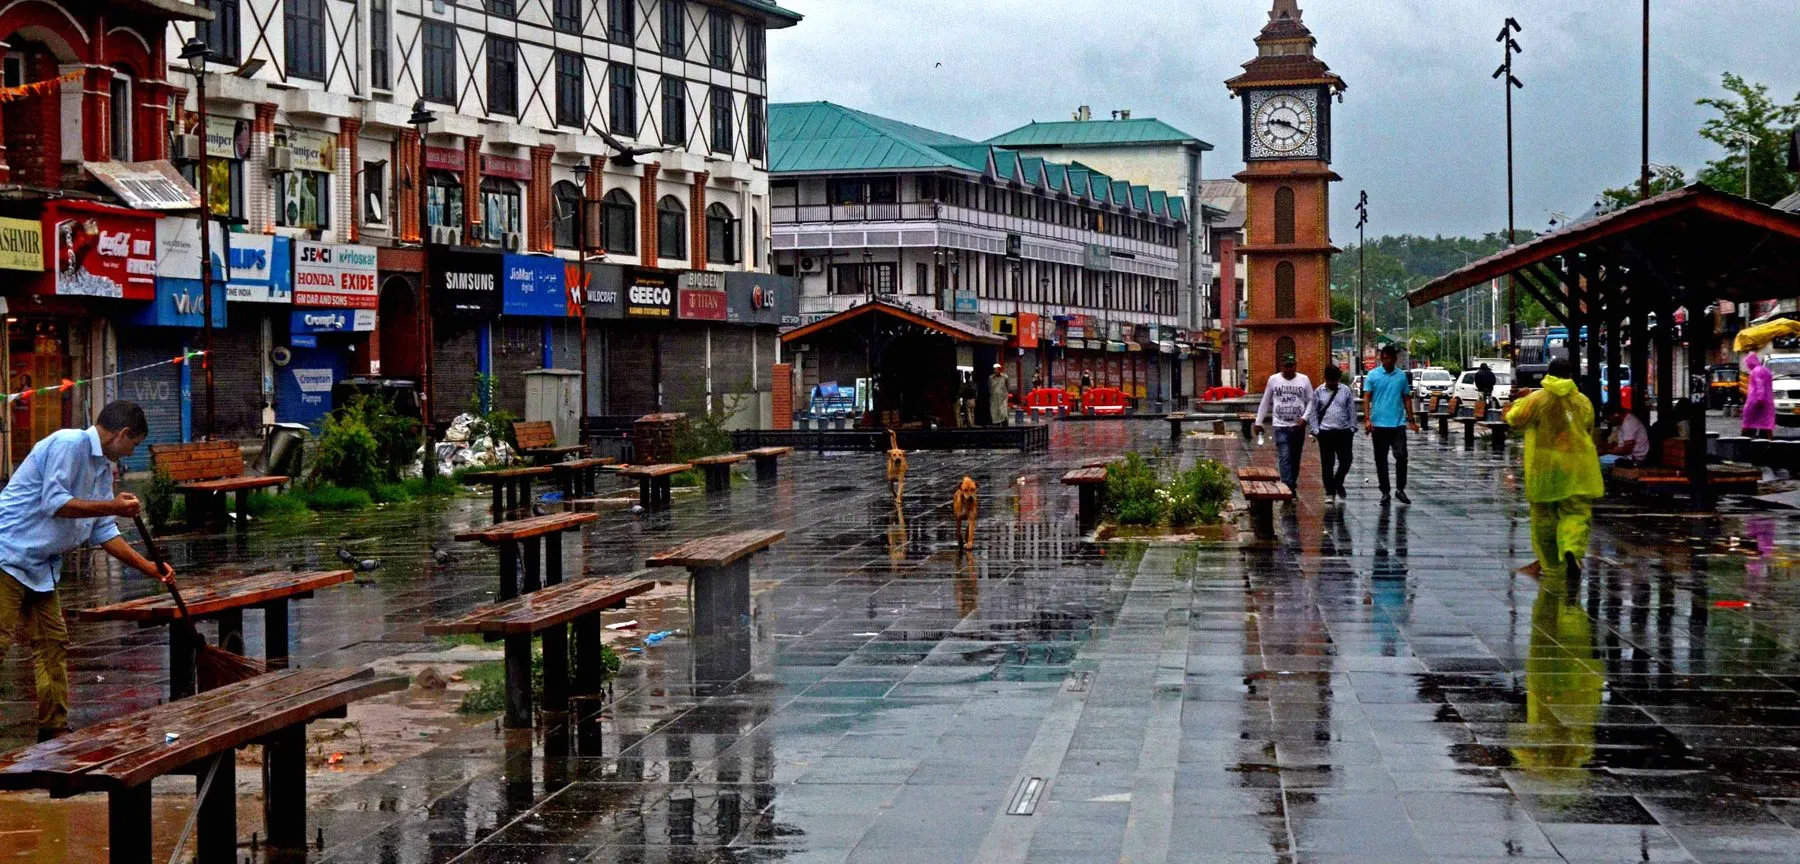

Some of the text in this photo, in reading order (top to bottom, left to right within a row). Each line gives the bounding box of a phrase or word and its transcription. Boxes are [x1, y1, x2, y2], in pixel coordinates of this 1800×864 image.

[206, 131, 232, 147] uniper
[297, 272, 335, 287] HONDA
[341, 272, 374, 290] EXIDE
[446, 271, 494, 291] SAMSUNG
[689, 272, 719, 288] BIG BEN
[319, 294, 332, 305] AND
[332, 295, 348, 306] SONS
[587, 290, 616, 304] WILDCRAFT
[629, 285, 671, 306] GEECO
[698, 294, 718, 309] TITAN
[764, 290, 775, 308] LG
[304, 313, 345, 328] Cromptn
[134, 377, 170, 401] vivo
